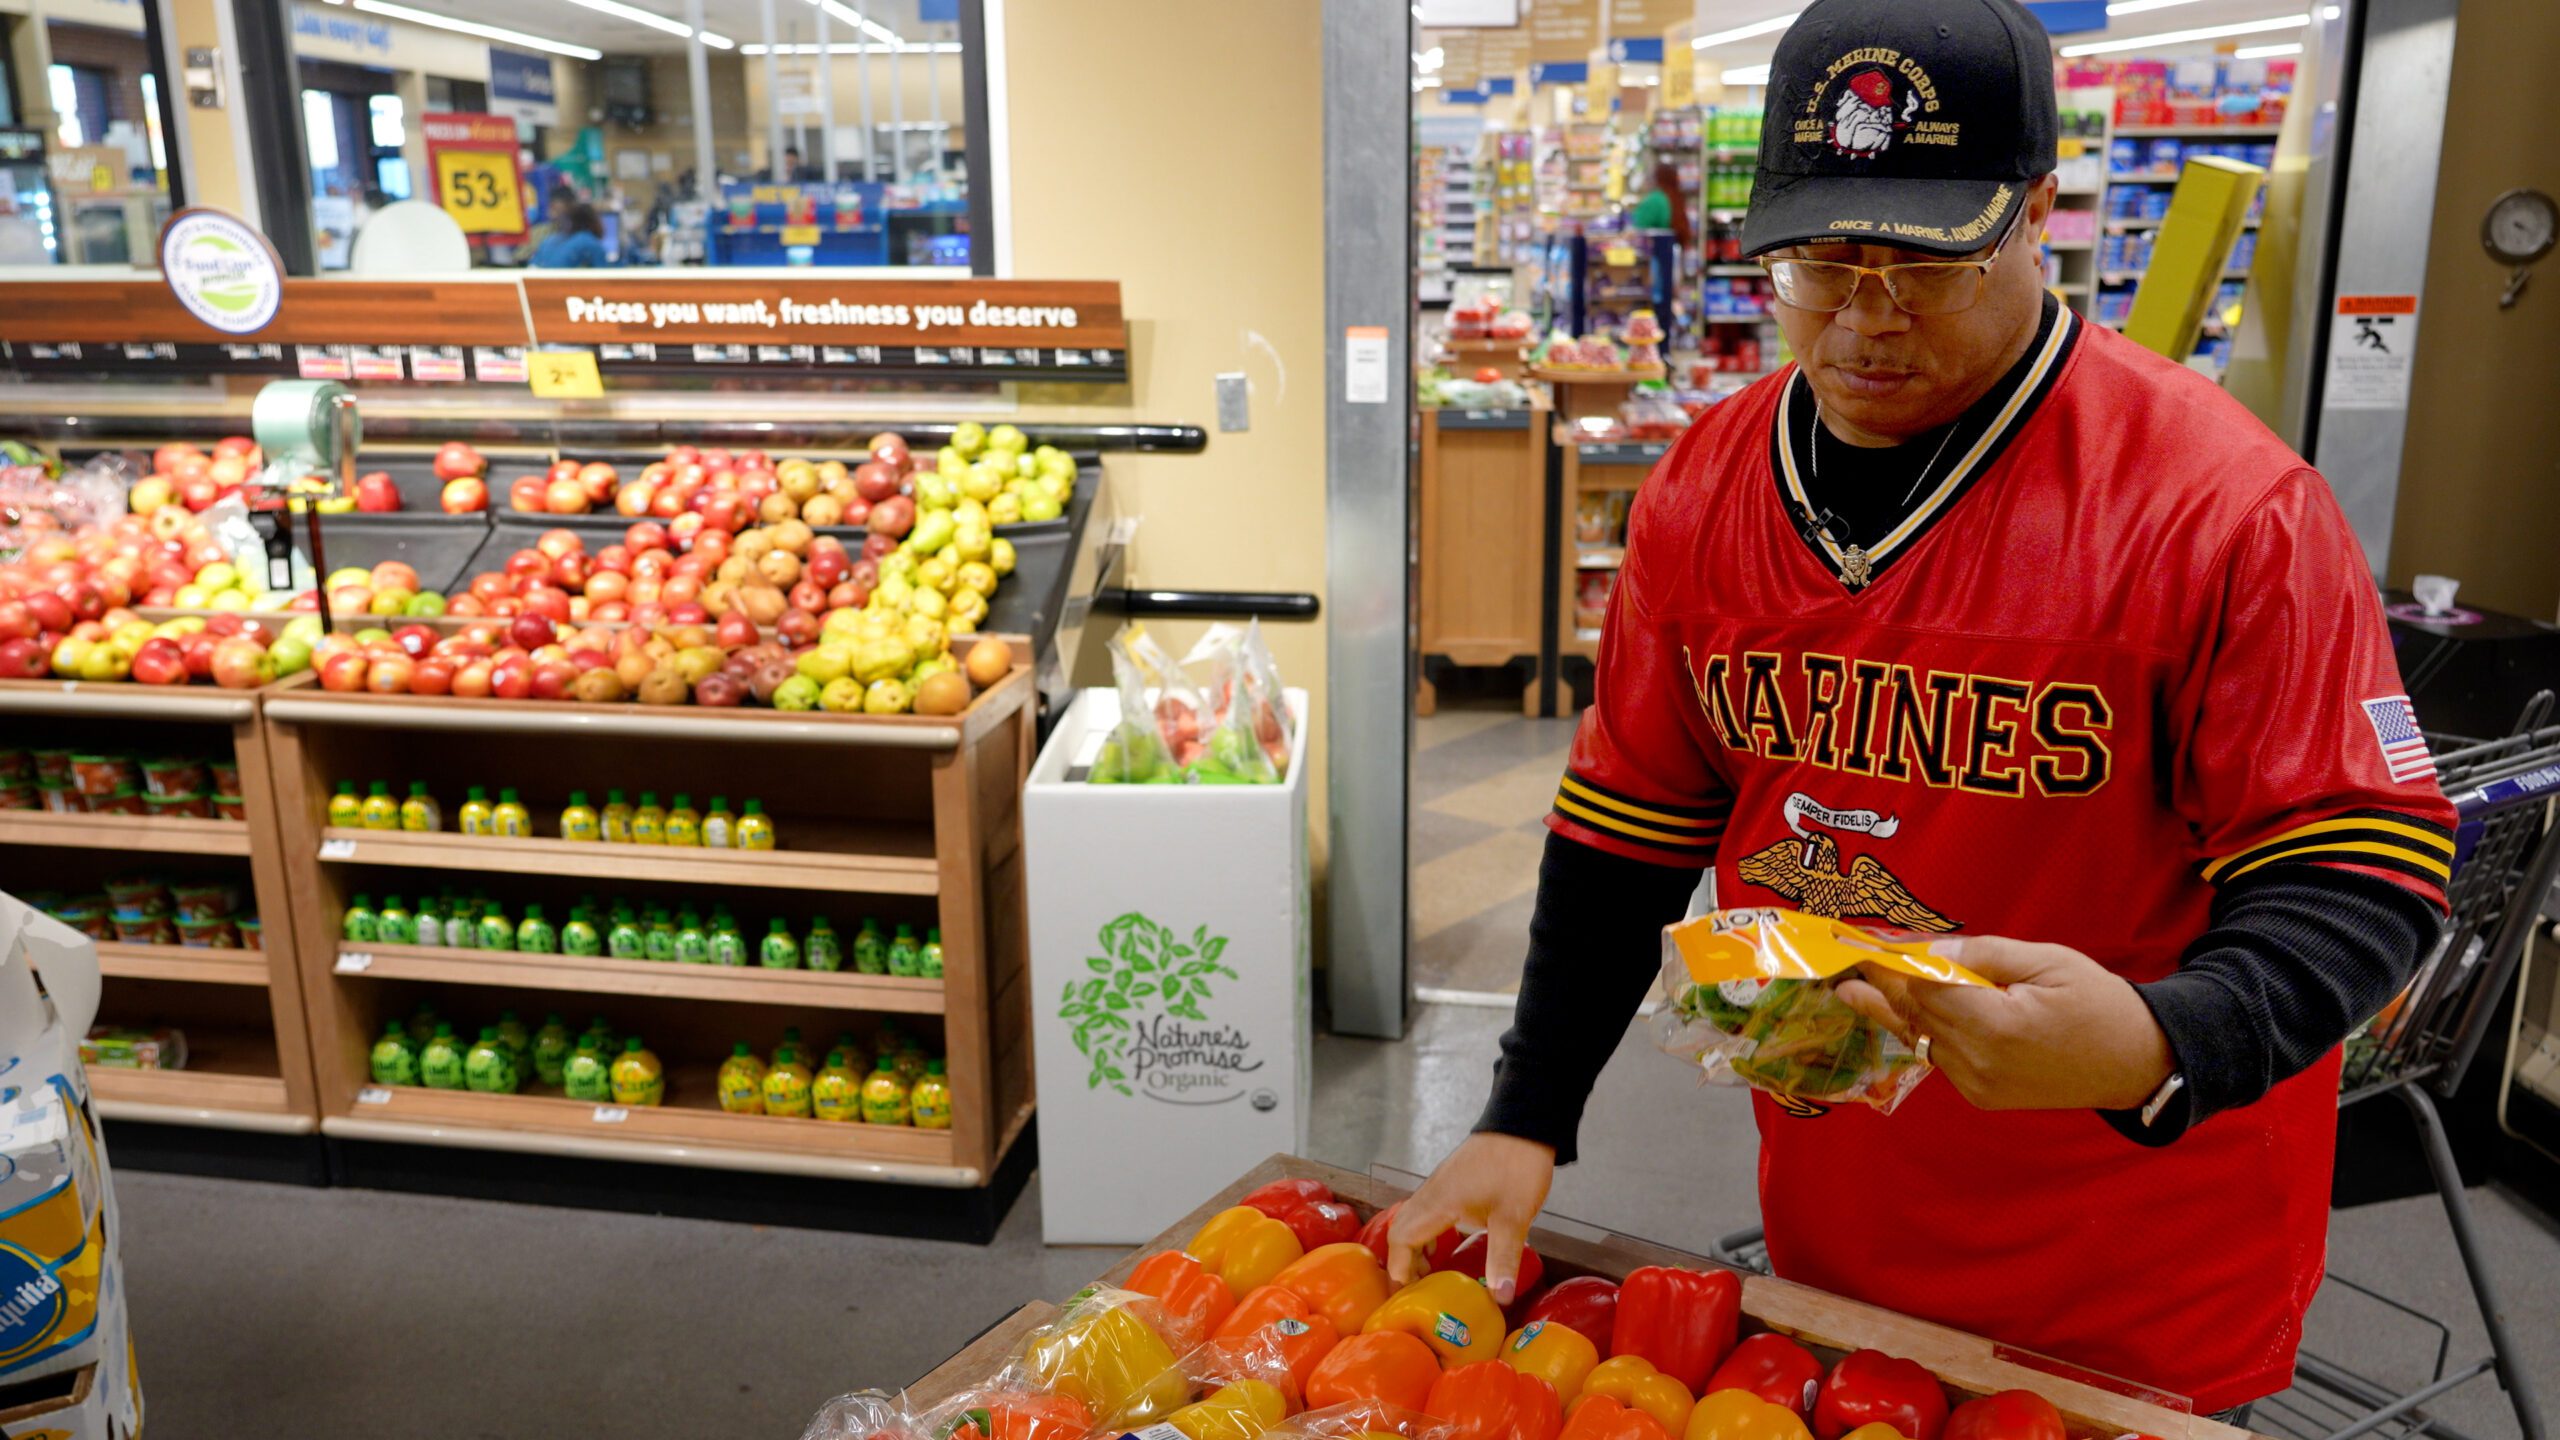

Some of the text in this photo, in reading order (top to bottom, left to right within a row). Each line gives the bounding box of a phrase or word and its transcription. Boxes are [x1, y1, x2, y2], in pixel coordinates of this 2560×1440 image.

[1806, 48, 1940, 113] U.S. MARINE CORPS
[1794, 118, 1824, 131] ONCE A
[1794, 130, 1823, 143] MARINE
[1903, 133, 1959, 146] A MARINE
[1915, 121, 1960, 134] ALWAYS
[1829, 219, 1873, 231] ONCE
[1878, 221, 1892, 233] A
[1894, 222, 1953, 243] MARINE,
[1950, 213, 1988, 243] ALWAYS
[1983, 183, 2014, 221] MARINE
[566, 296, 1078, 331] Prices you want, freshness you deserve
[1683, 645, 2113, 798] MARINES
[1792, 796, 1872, 827] SEMPER FIDELIS
[1136, 1013, 1250, 1051] Nature's
[1127, 1048, 1265, 1081] Promise
[1147, 1070, 1230, 1094] Organic
[0, 1273, 60, 1333] quita
